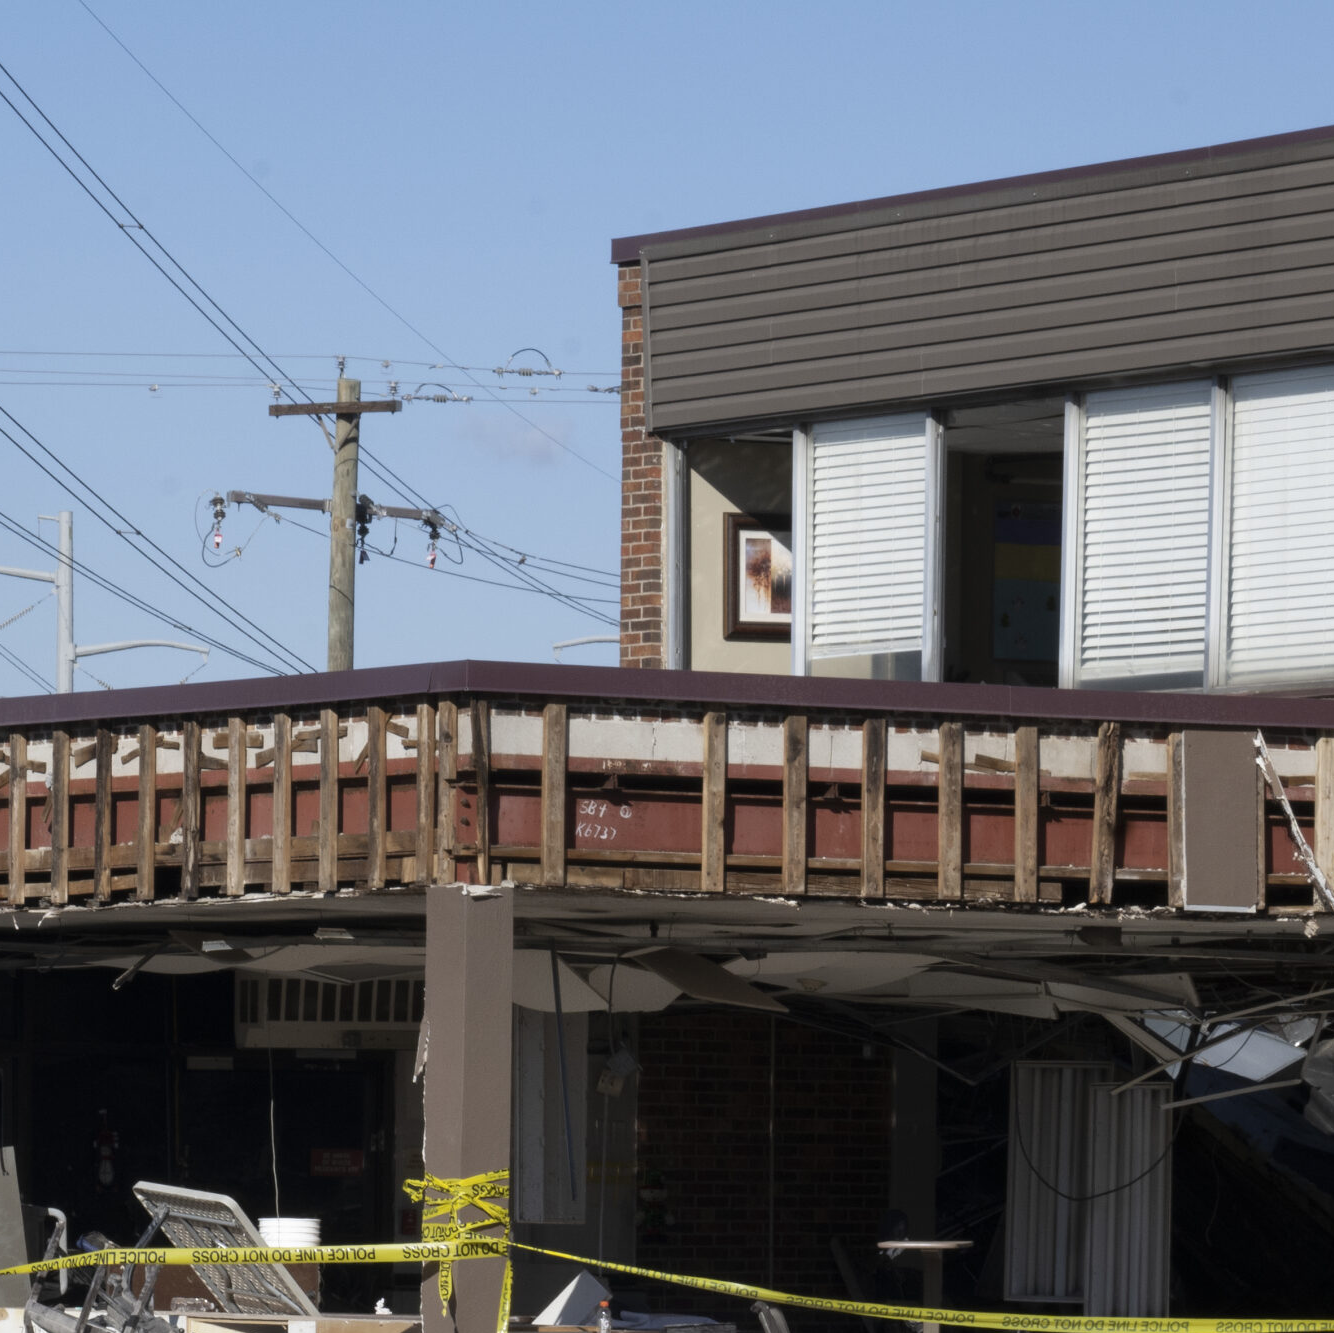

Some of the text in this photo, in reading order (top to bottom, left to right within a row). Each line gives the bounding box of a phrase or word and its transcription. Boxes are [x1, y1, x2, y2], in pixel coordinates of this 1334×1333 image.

[403, 1245, 450, 1259] CROSS
[453, 1244, 479, 1258] NOT
[481, 1242, 499, 1255] DO
[78, 1255, 92, 1266] DO
[93, 1252, 116, 1266] LINE
[119, 1251, 166, 1264] POLICE
[193, 1248, 376, 1263] POLICE LINE DO NOT CROSS
[31, 1262, 59, 1272] CROSS
[61, 1258, 79, 1268] NOT
